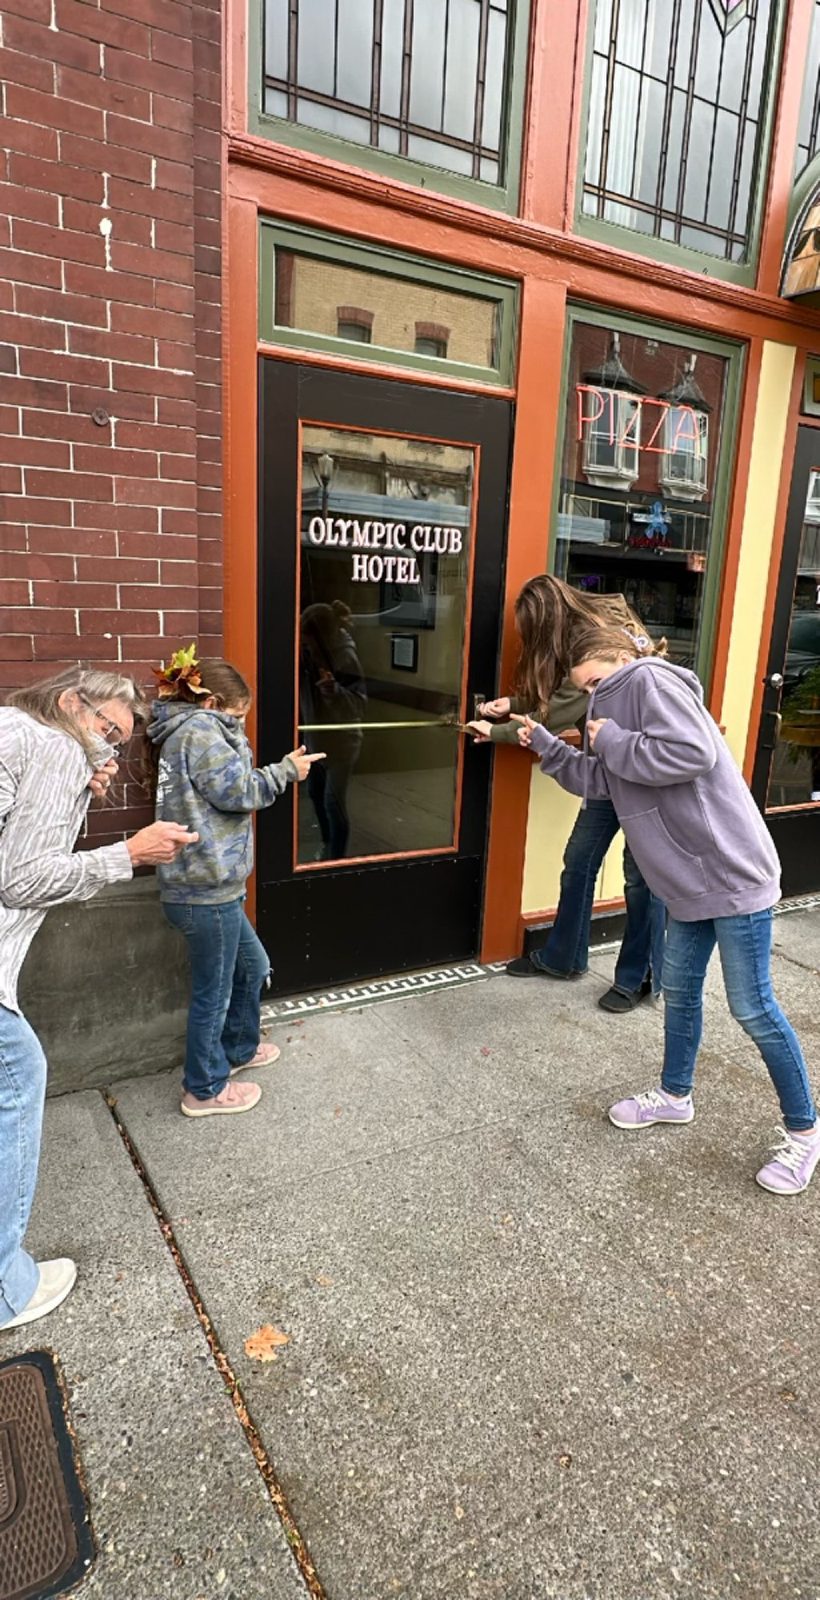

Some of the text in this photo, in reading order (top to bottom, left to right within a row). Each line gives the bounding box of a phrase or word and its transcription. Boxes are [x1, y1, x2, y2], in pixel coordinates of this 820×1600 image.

[576, 384, 701, 458] PIZZA
[308, 516, 463, 554] OLYMPIC CLUB
[351, 554, 420, 584] HOTEL
